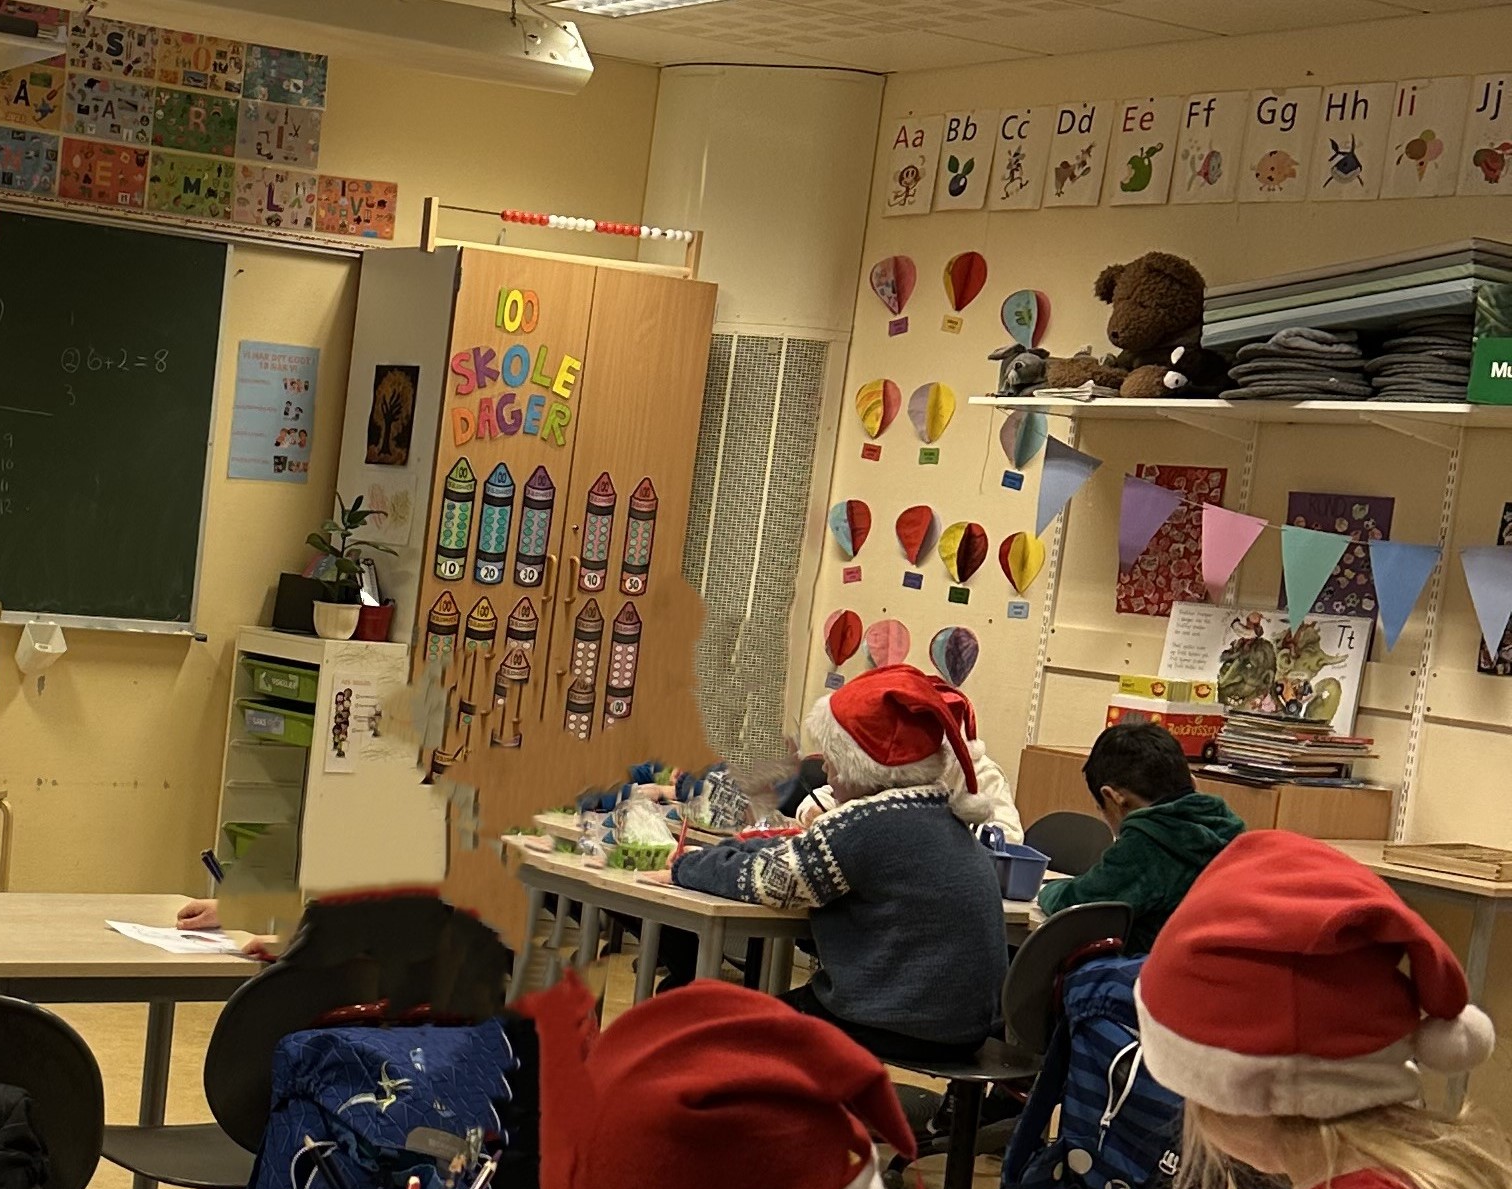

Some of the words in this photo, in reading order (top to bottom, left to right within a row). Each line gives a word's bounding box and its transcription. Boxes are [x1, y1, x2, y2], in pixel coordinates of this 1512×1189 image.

[105, 31, 125, 58] S
[192, 46, 211, 73] O
[1186, 98, 1217, 128] Ff
[1256, 96, 1299, 132] Gg
[1325, 90, 1369, 122] Hh
[1396, 86, 1418, 117] Ii
[1476, 80, 1505, 121] Jj
[189, 106, 207, 134] R
[945, 115, 978, 143] Bb
[1001, 114, 1031, 140] Cc
[1056, 106, 1096, 135] Dd
[1121, 105, 1155, 132] Ee
[892, 124, 926, 150] Aa
[94, 160, 113, 187] E
[182, 176, 202, 196] M
[267, 182, 285, 212] L
[495, 286, 540, 334] 100
[451, 343, 583, 400] SKOLE
[451, 392, 573, 448] DAGER
[442, 561, 457, 576] 10
[483, 567, 496, 580] 20
[521, 568, 536, 581] 30
[586, 574, 599, 587] 40
[627, 578, 640, 591] 50
[1337, 624, 1355, 650] Tt
